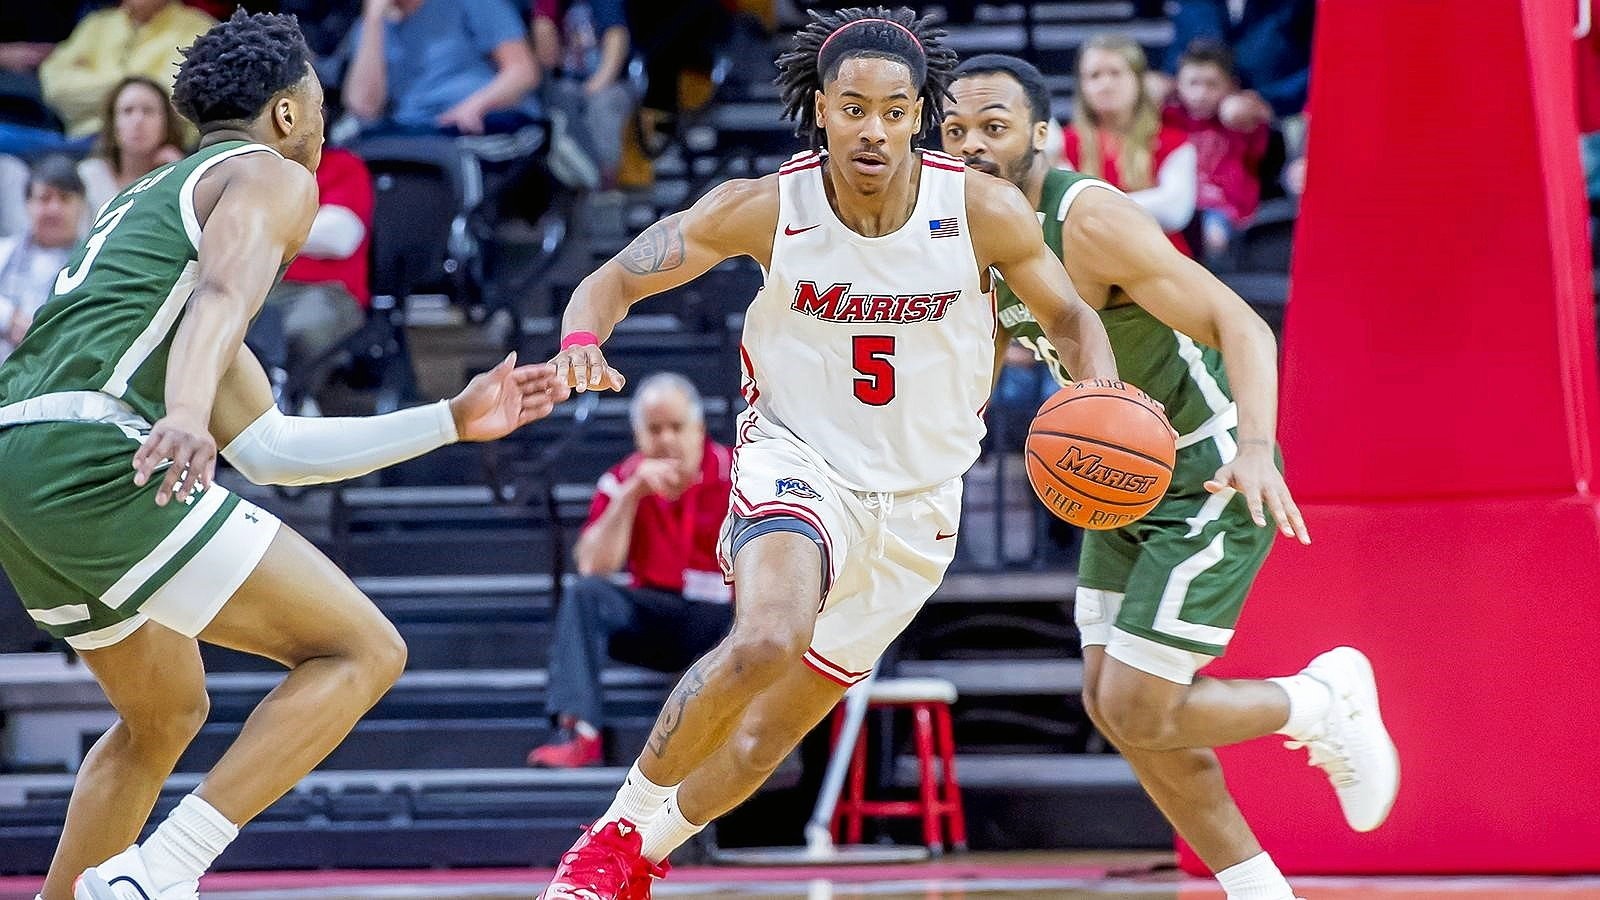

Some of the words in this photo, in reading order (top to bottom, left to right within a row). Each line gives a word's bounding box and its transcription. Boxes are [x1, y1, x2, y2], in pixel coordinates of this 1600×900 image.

[791, 280, 962, 324] MARIST
[852, 335, 896, 406] 5
[1056, 446, 1158, 494] MARIST
[1044, 483, 1082, 518] THE
[1087, 509, 1138, 526] ROC
